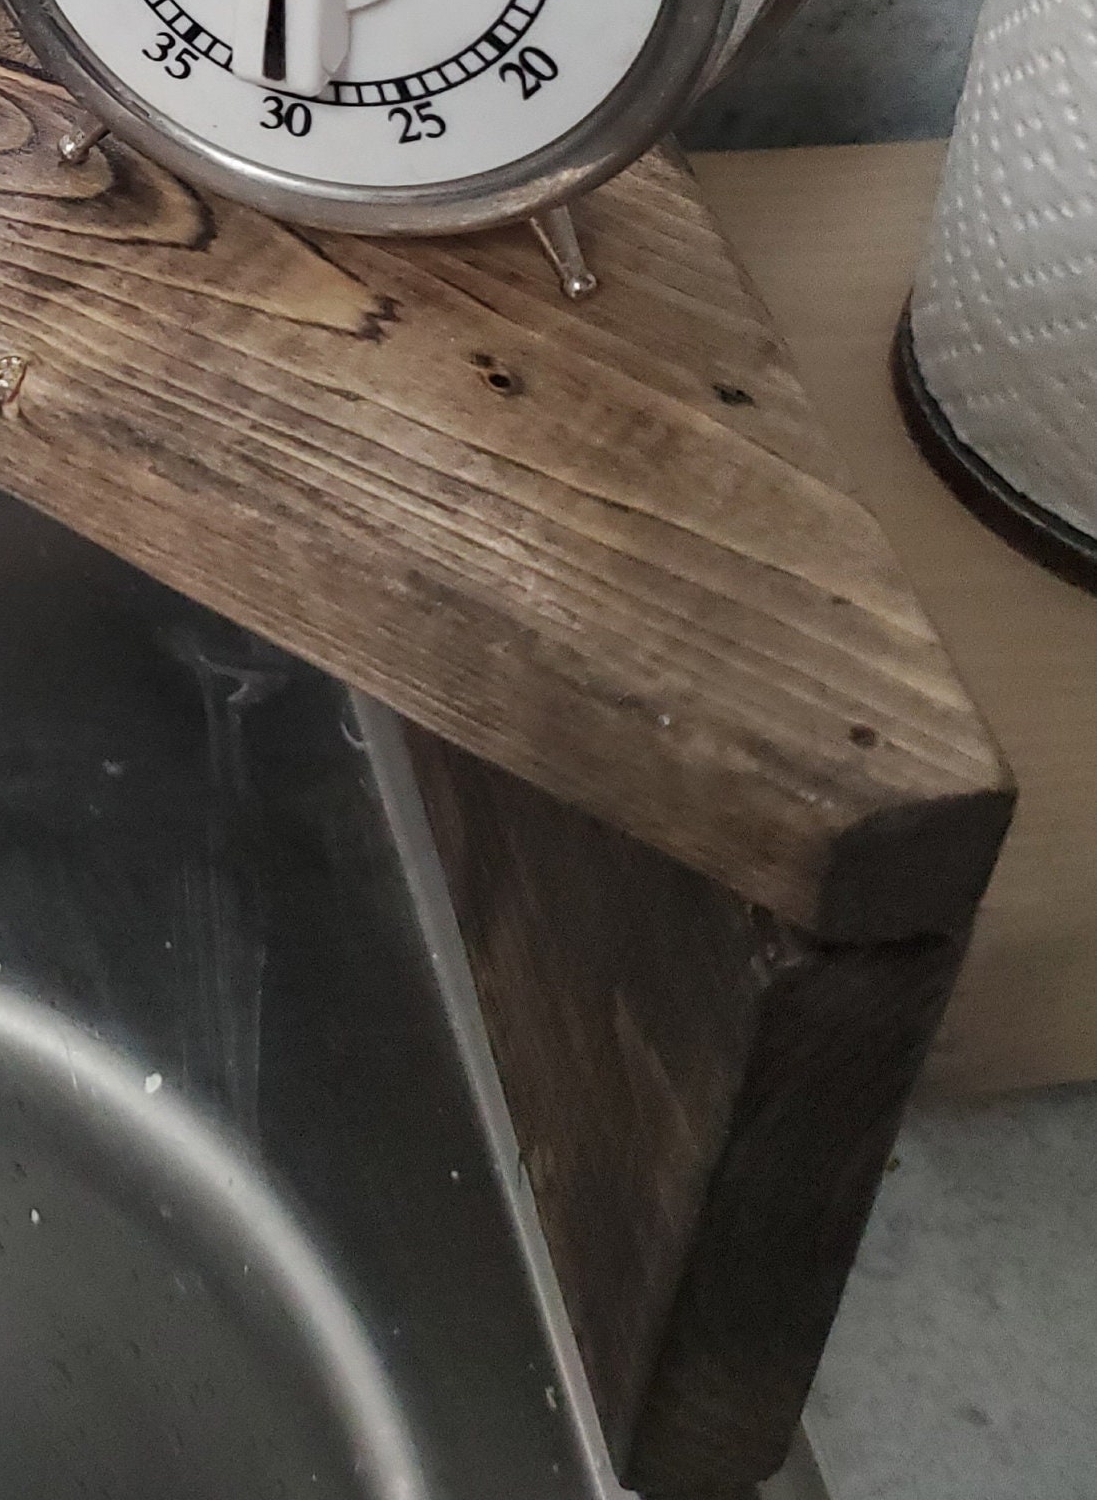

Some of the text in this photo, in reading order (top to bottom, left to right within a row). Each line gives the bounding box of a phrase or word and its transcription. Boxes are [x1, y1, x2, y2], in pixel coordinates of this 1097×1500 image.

[141, 31, 200, 80] 35
[498, 45, 559, 100] 20
[259, 94, 313, 138] 30
[387, 100, 447, 144] 25
